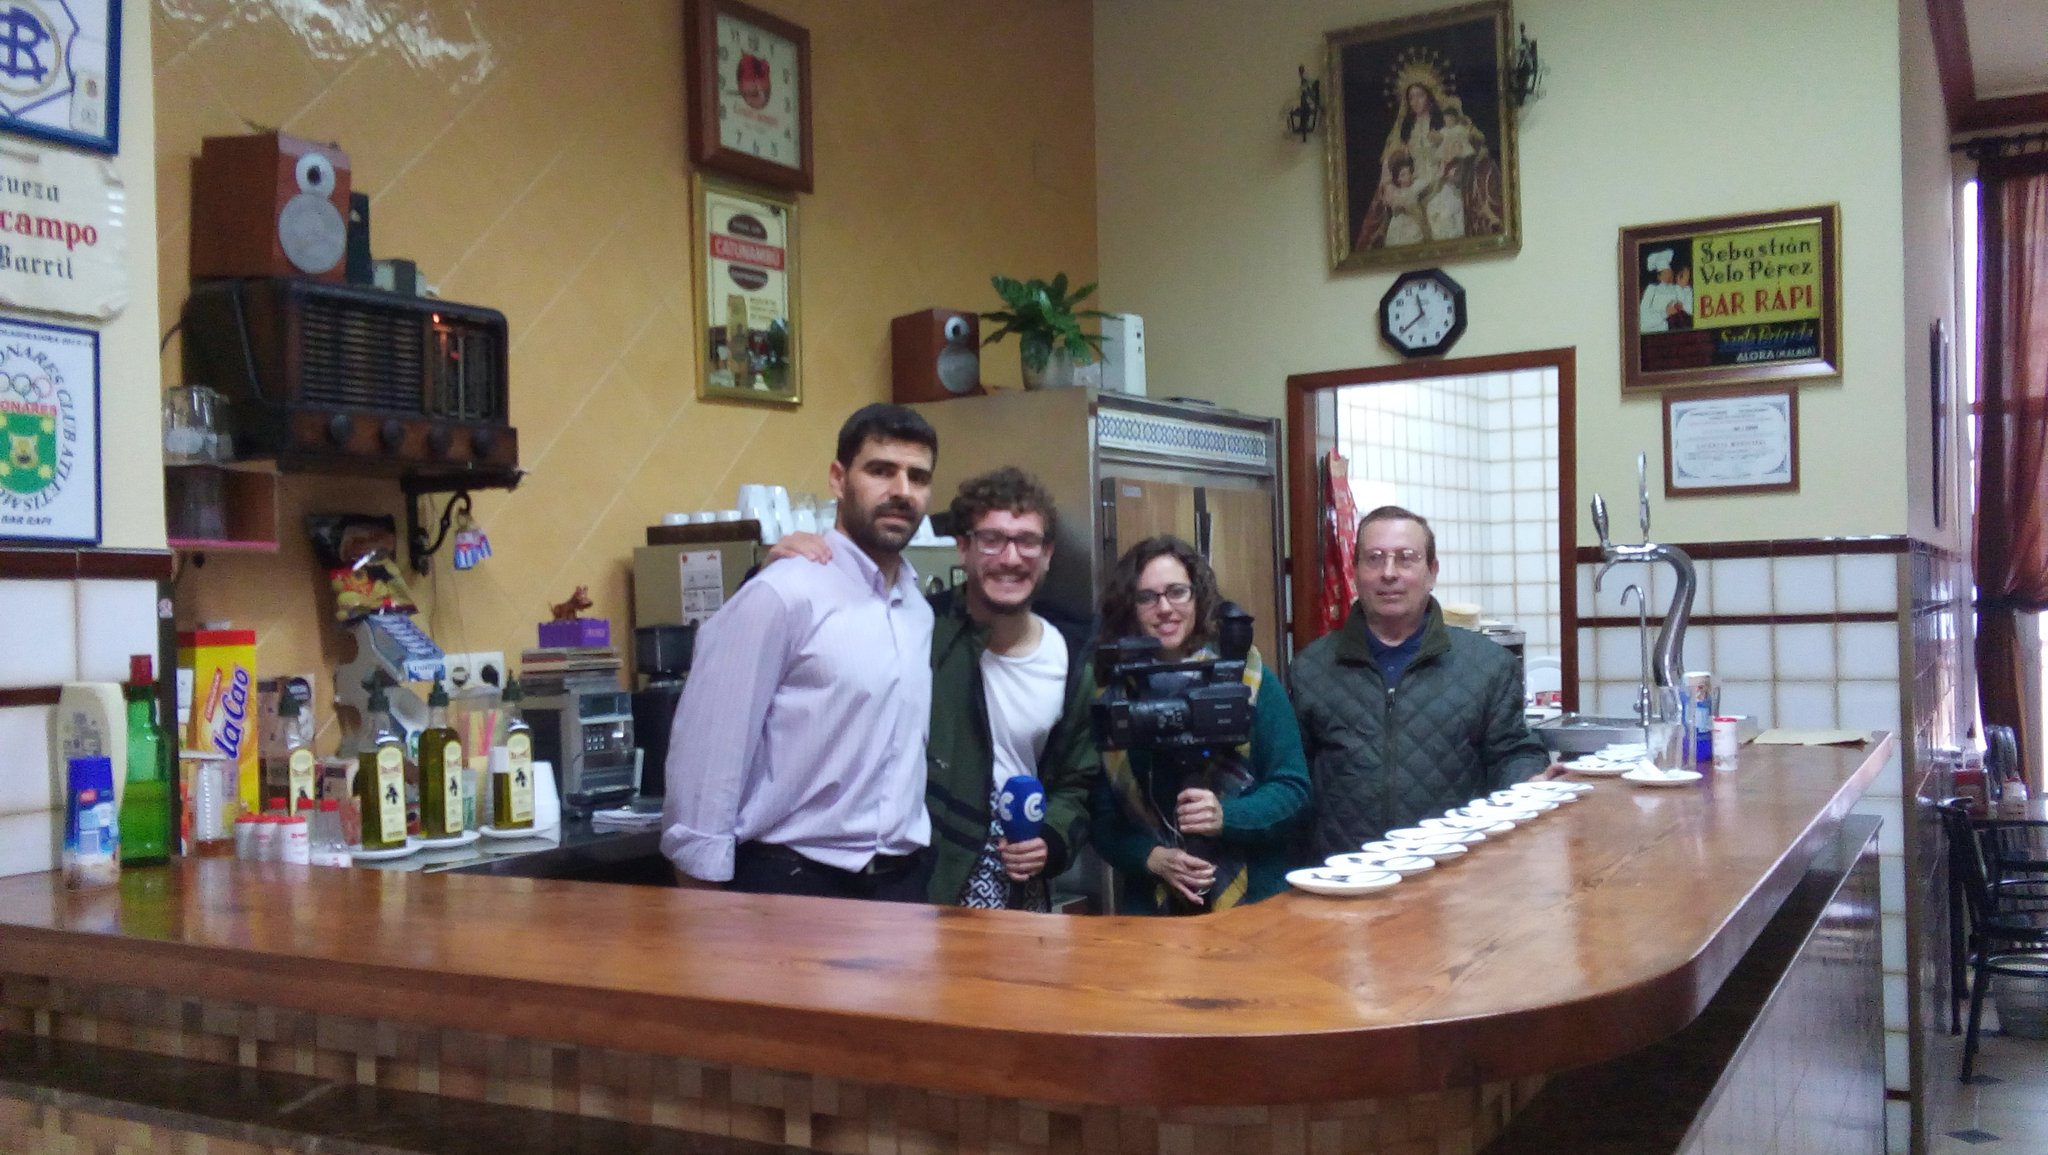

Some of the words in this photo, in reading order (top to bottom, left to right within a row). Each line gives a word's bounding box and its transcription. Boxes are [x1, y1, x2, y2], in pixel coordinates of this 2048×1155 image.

[1701, 236, 1812, 264] Sebastián
[1700, 264, 1744, 286] Velo
[1749, 260, 1814, 281] Pérez
[1700, 292, 1746, 319] BAR
